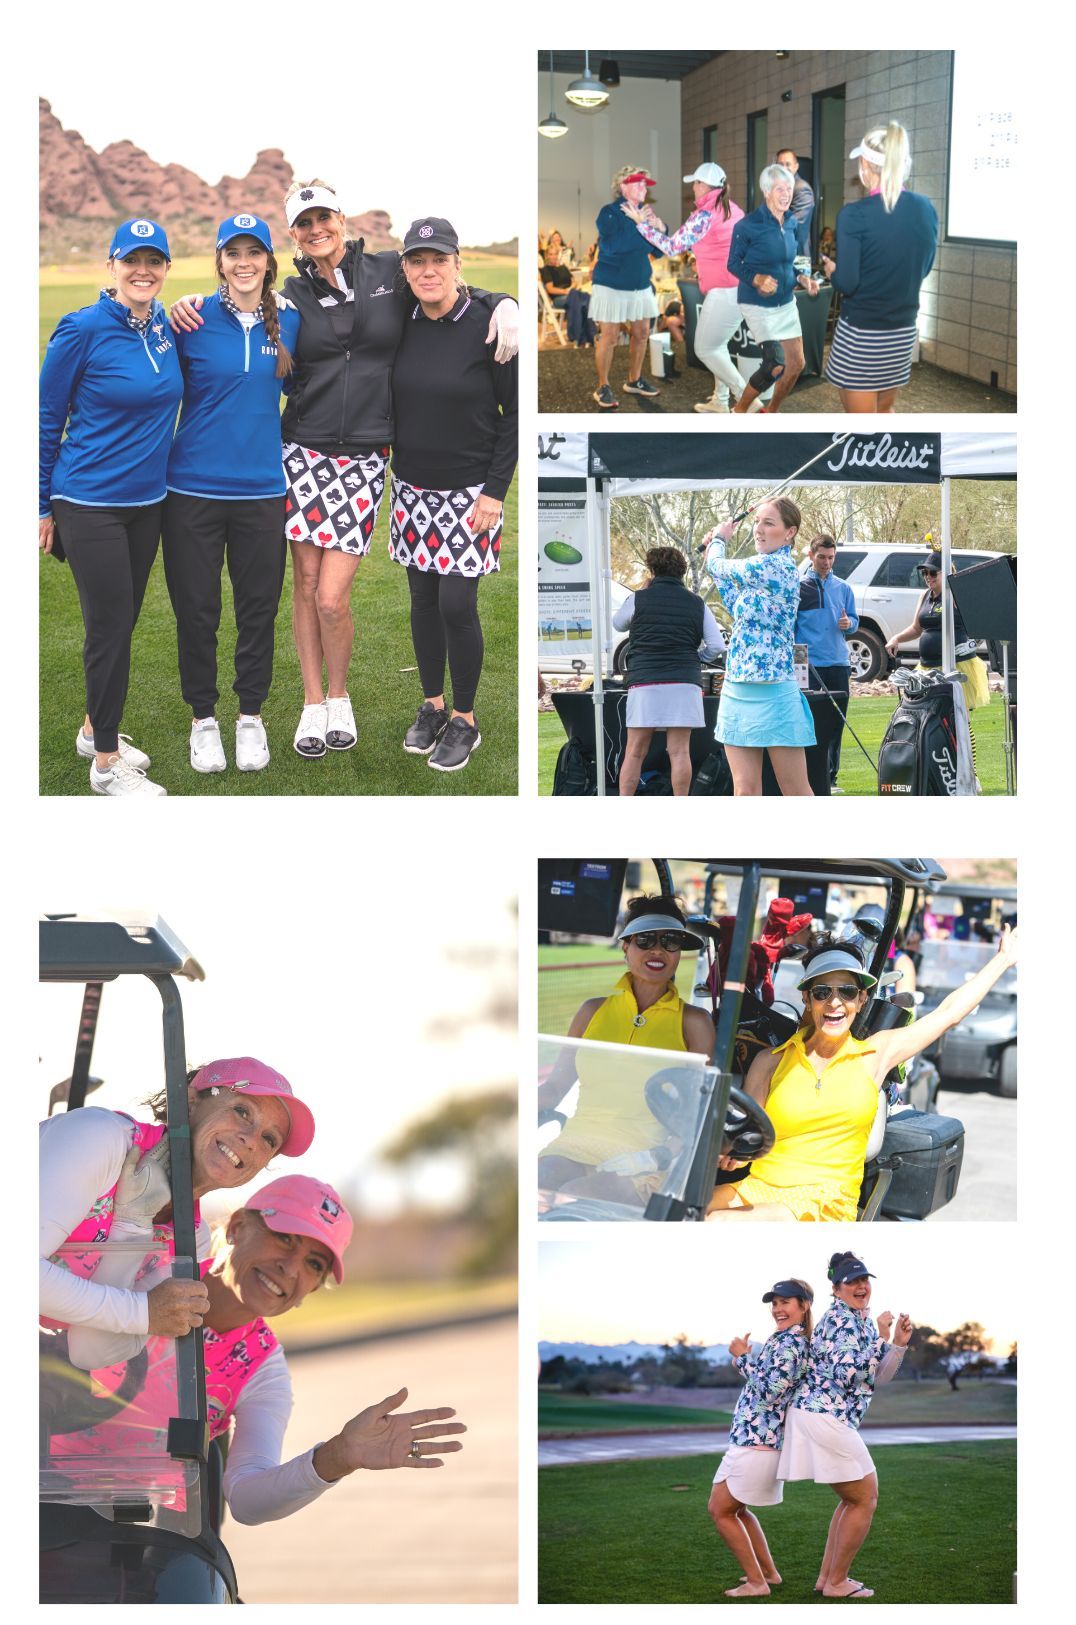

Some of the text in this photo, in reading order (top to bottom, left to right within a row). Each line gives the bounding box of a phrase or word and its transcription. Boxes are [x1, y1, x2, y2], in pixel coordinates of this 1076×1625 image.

[827, 432, 934, 472] Titleist
[881, 784, 912, 793] FIT CREW
